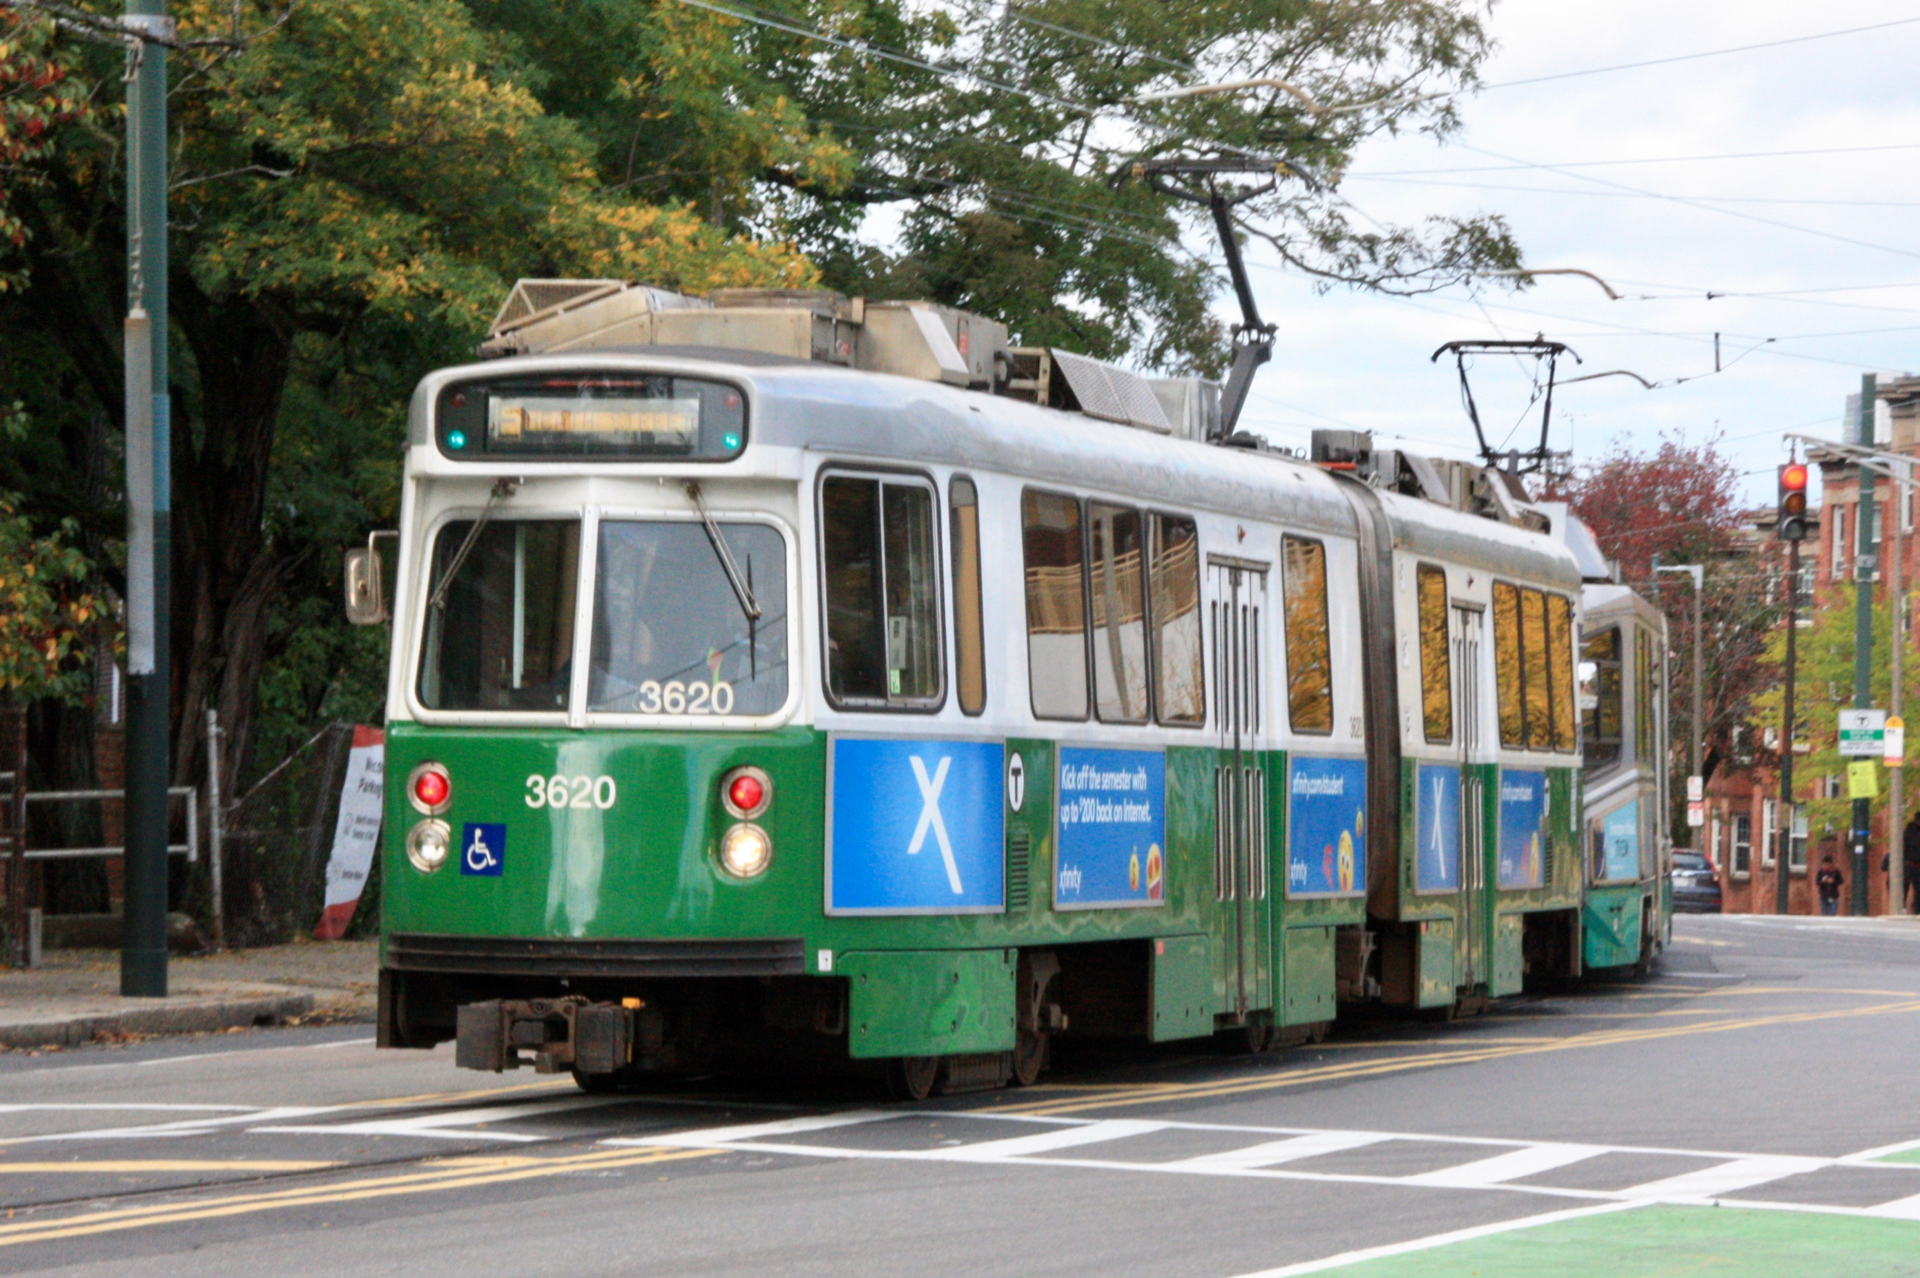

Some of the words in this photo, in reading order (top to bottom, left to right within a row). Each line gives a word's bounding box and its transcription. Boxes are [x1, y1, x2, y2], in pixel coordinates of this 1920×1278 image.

[638, 680, 734, 715] 3620
[523, 774, 617, 810] 3620
[1011, 767, 1022, 803] T
[1062, 764, 1076, 790] Kick
[1077, 764, 1089, 790] off
[1090, 765, 1101, 790] the
[1101, 769, 1132, 790] semester
[1132, 765, 1147, 790] with
[907, 755, 964, 895] X
[1061, 804, 1070, 830] up
[1070, 800, 1079, 823] to
[1096, 797, 1113, 823] back
[1113, 804, 1123, 823] on
[1059, 863, 1082, 895] xfinity
